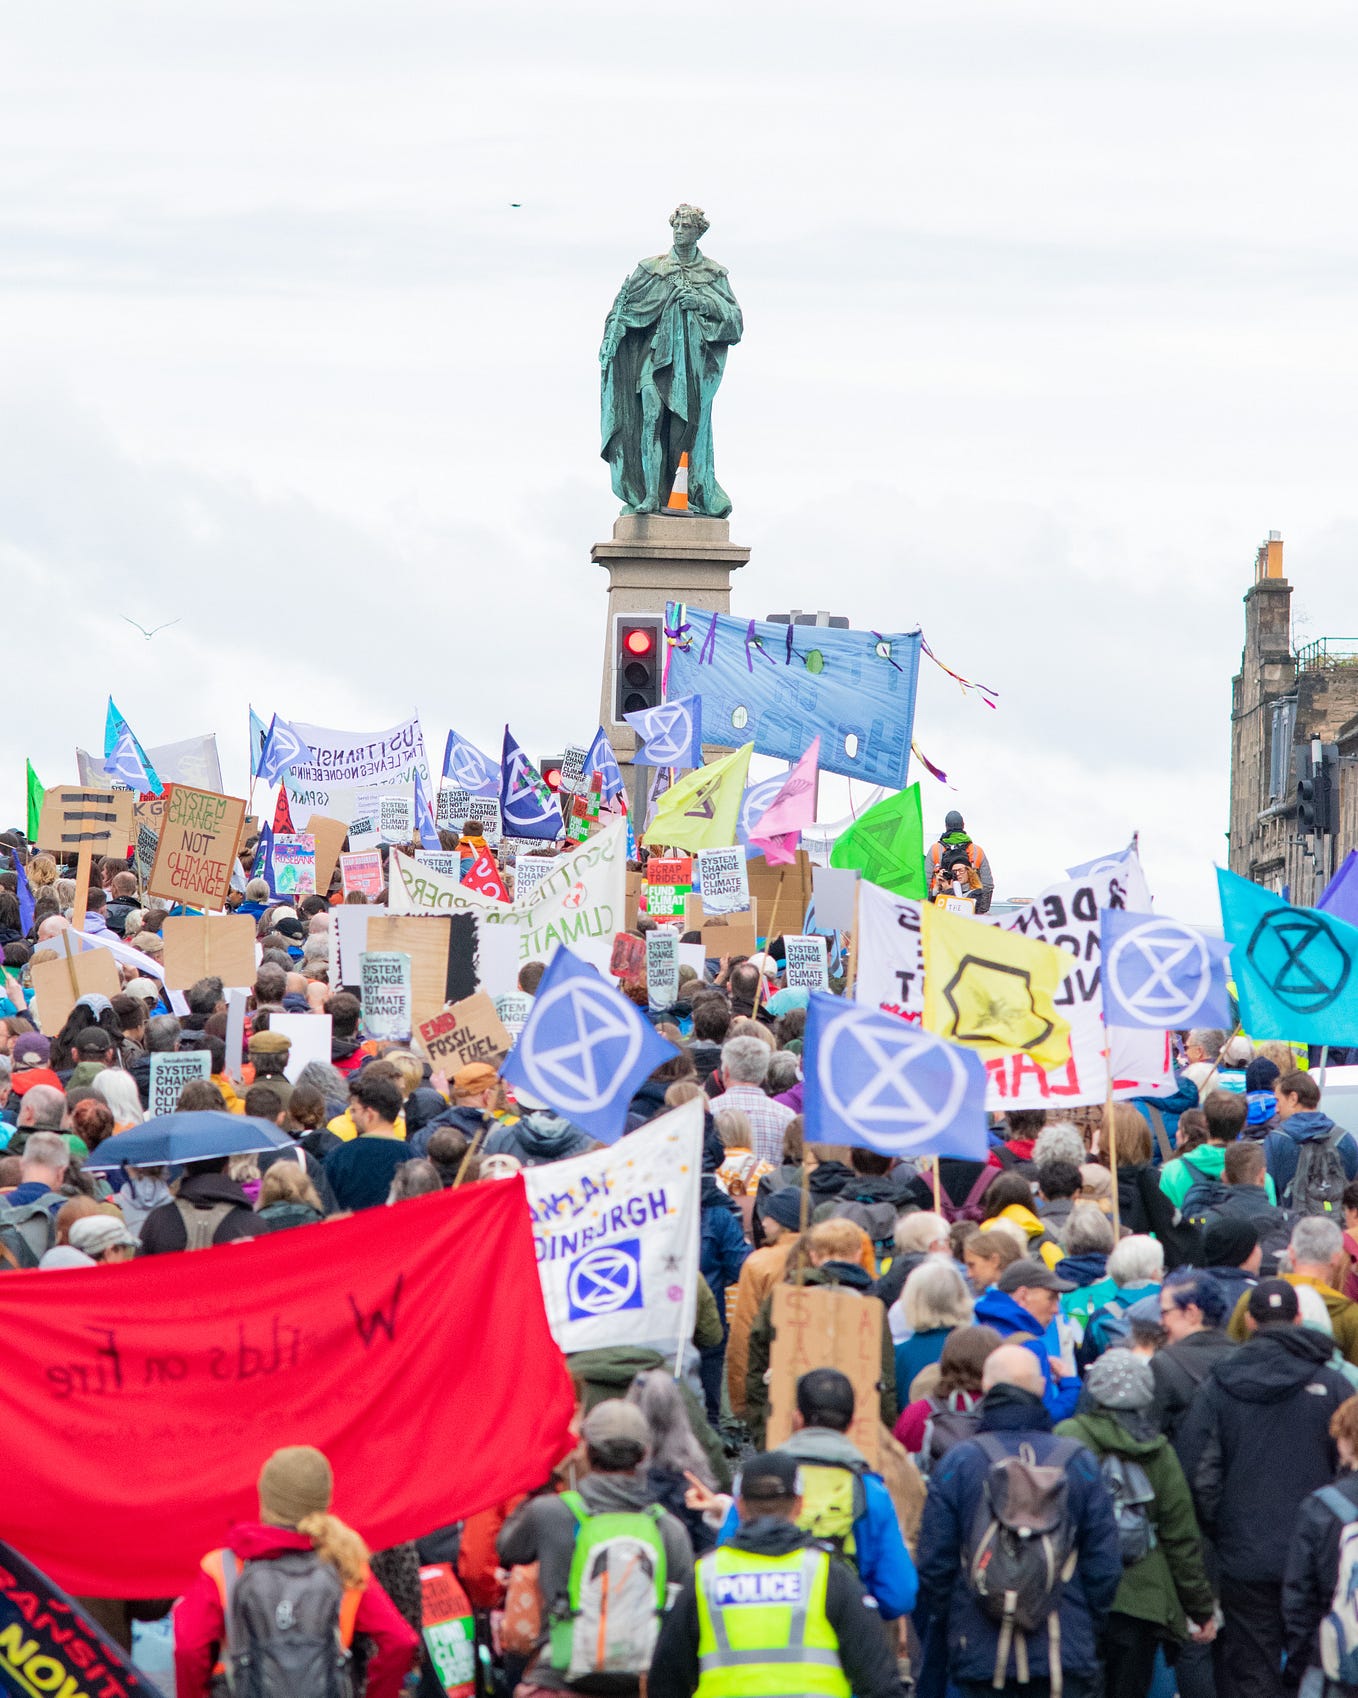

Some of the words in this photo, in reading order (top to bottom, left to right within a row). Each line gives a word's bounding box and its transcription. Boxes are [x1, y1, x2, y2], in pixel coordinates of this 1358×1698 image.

[175, 788, 226, 819] SYSTEM
[168, 802, 220, 833] CHANGE
[381, 818, 409, 826] CLIMATE
[349, 820, 370, 832] SYSTEM
[181, 830, 215, 855] NOT
[701, 855, 737, 866] SYSTEM
[168, 852, 226, 882] CLIMATE
[650, 865, 682, 874] SCRAP
[702, 862, 740, 873] CHANGE
[650, 874, 690, 883] TRIDENT
[703, 872, 720, 880] NOT
[171, 869, 224, 896] CHANGE
[703, 878, 741, 888] CLIMATE
[648, 886, 675, 896] FUND
[704, 886, 741, 896] CHANGE
[648, 895, 684, 905] CLIMAT
[648, 904, 674, 914] JOBS
[648, 941, 672, 950] SYSTEM
[788, 945, 820, 954] SYSTEM
[650, 950, 674, 960] CHANGE
[788, 954, 822, 962] CHANGE
[362, 964, 402, 974] SYSTEM
[650, 960, 662, 968] NOT
[789, 962, 804, 970] NOT
[650, 968, 675, 978] CLIMATE
[790, 970, 822, 979] CLIMATE
[363, 974, 404, 984] CHANGE
[650, 978, 674, 987] CHANGE
[790, 978, 822, 986] CHANGE
[364, 986, 380, 994] NOT
[364, 996, 406, 1005] CLIMATE
[365, 1006, 406, 1016] CHANGE
[419, 1012, 456, 1042] END
[426, 1026, 476, 1061] FOSSIL
[458, 1036, 498, 1066] FUEL
[156, 1064, 202, 1075] SYSTEM
[156, 1086, 180, 1096] NOT
[716, 1572, 801, 1604] POLICE
